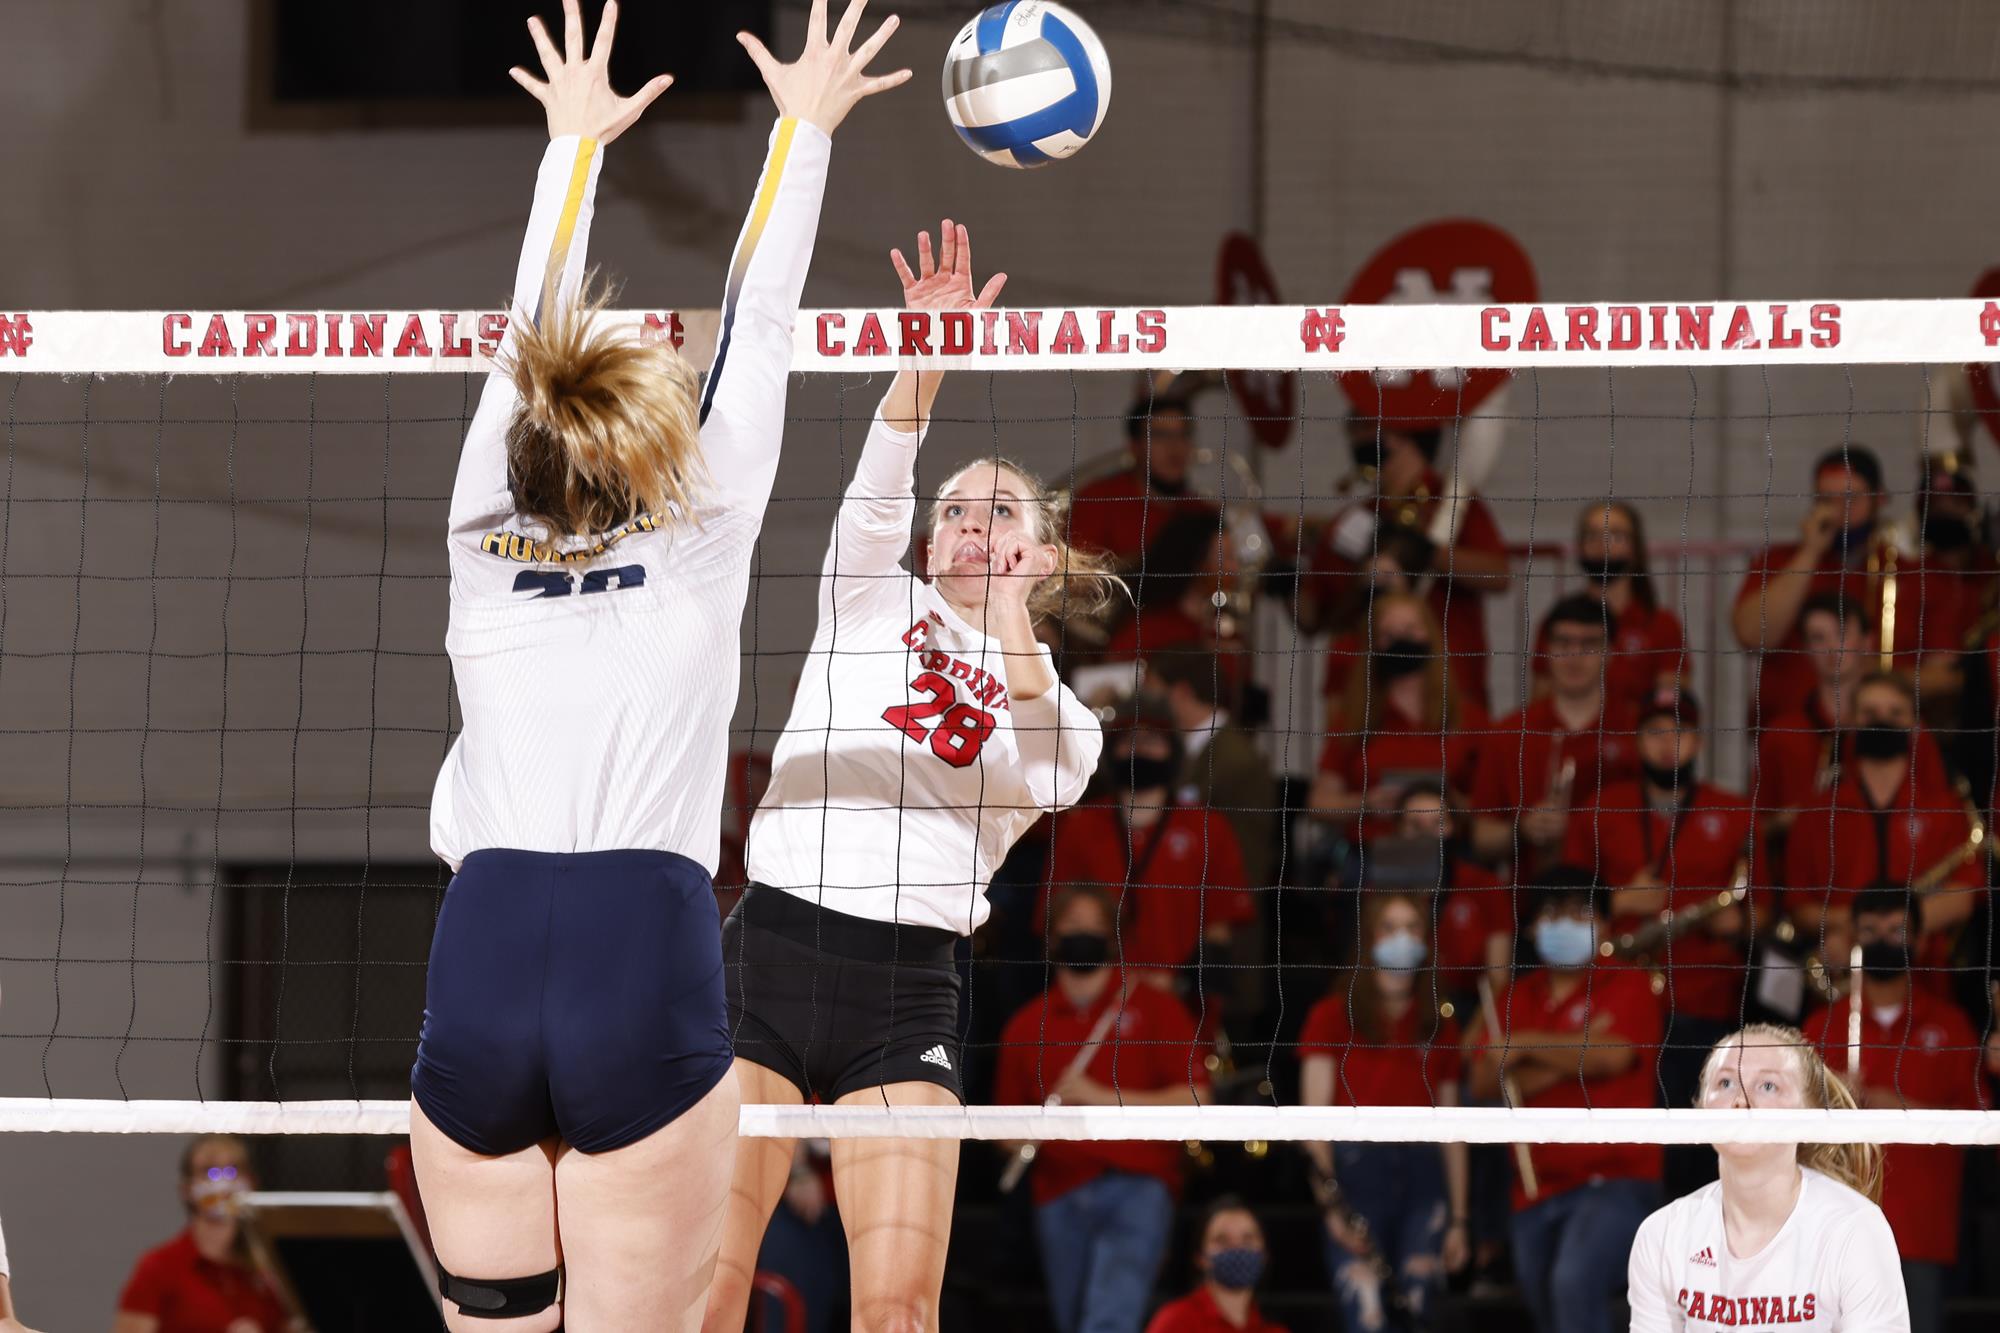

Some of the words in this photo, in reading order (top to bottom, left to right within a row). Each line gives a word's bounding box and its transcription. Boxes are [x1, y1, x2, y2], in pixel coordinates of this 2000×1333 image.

[163, 313, 509, 358] CARDINALS
[816, 310, 1167, 356] CARDINALS
[1481, 303, 1842, 351] CARDINALS
[881, 672, 996, 768] 28
